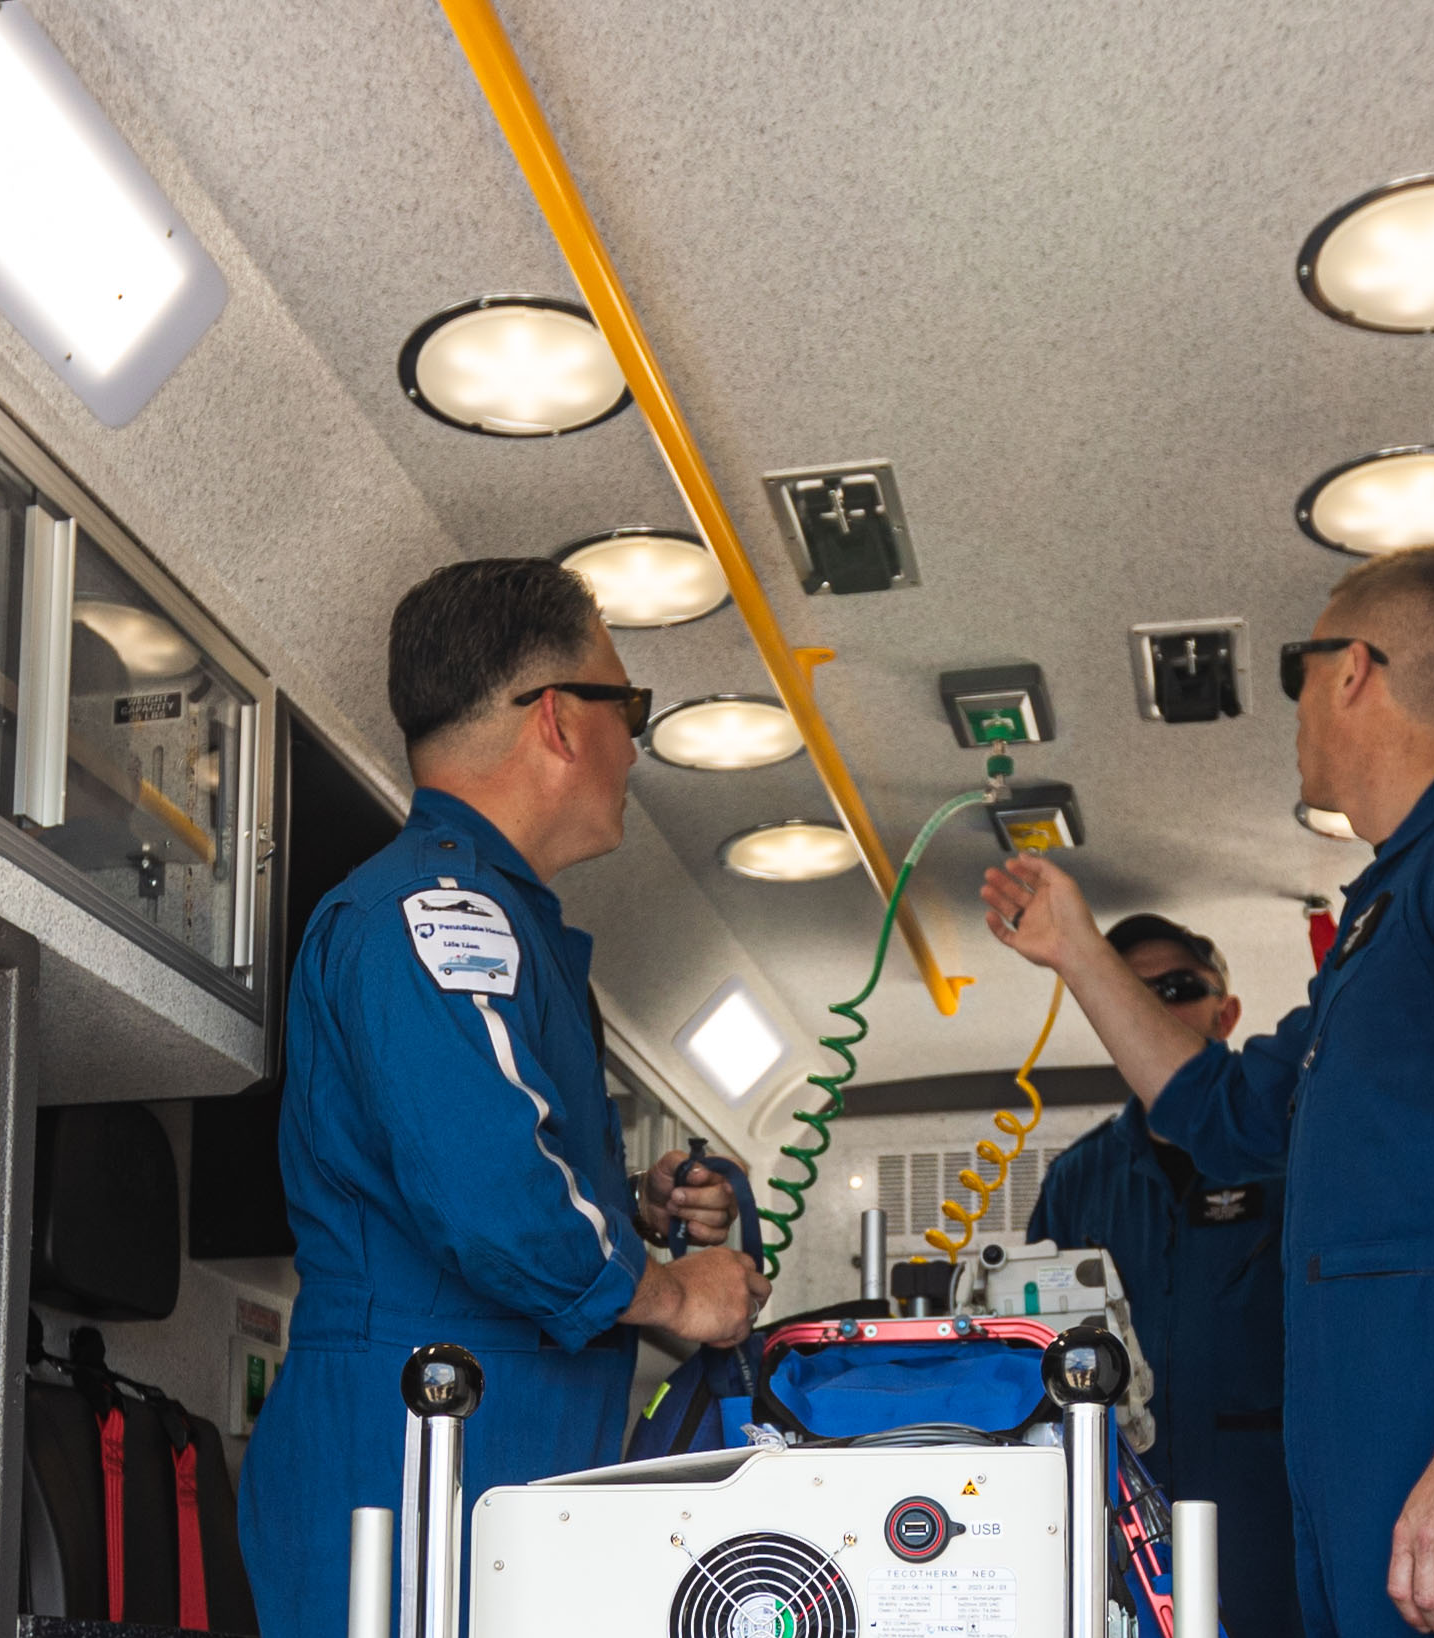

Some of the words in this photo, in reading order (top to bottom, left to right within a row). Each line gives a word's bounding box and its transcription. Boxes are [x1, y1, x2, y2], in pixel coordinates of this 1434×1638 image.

[120, 702, 175, 715] CAPACITY
[971, 1523, 1001, 1535] USB
[887, 1570, 958, 1578] TECOTHERM
[972, 1570, 996, 1578] NEO
